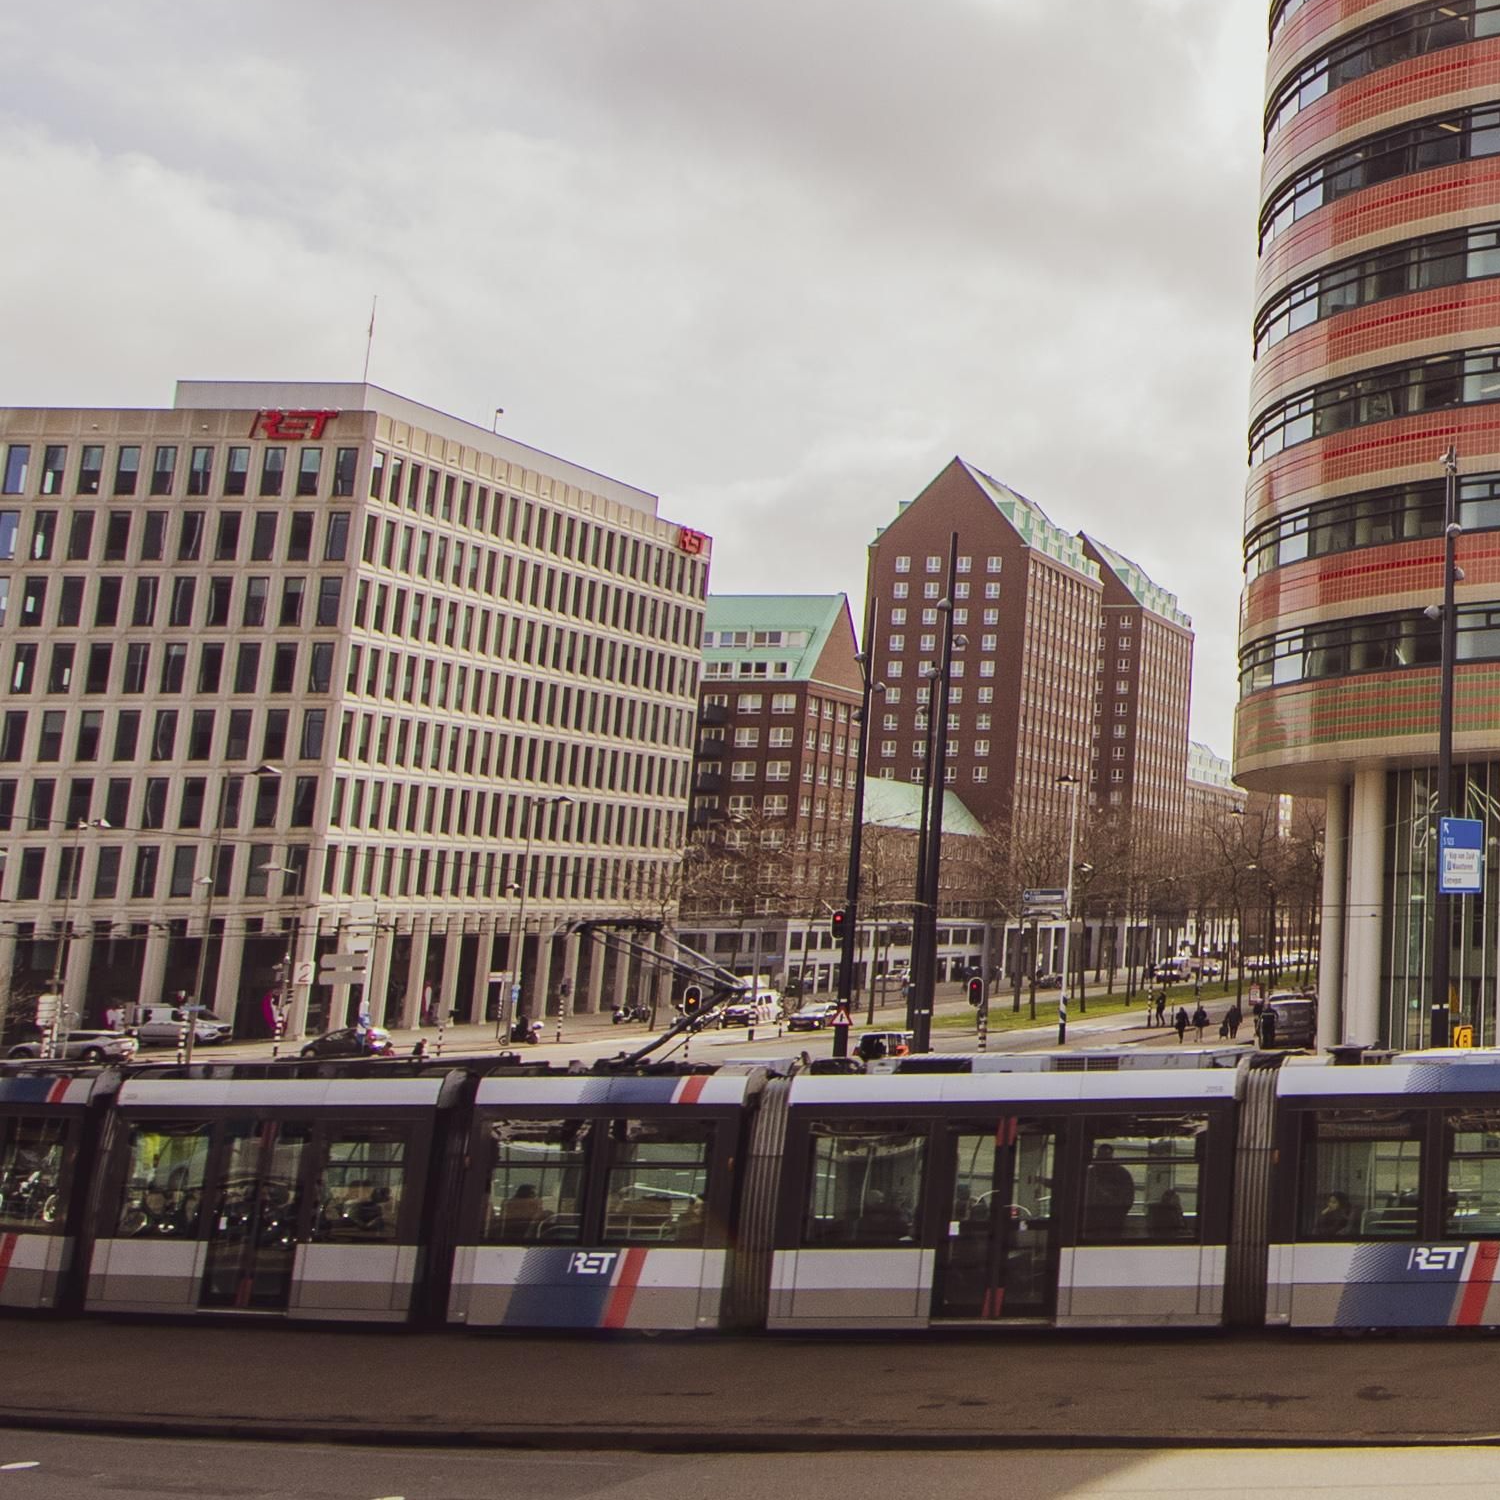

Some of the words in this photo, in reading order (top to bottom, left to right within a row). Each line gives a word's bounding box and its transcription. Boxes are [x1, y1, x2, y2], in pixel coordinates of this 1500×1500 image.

[248, 410, 338, 440] RET
[679, 528, 703, 555] RET
[298, 963, 311, 983] 2
[567, 1252, 617, 1274] RET
[1407, 1247, 1465, 1270] RET
